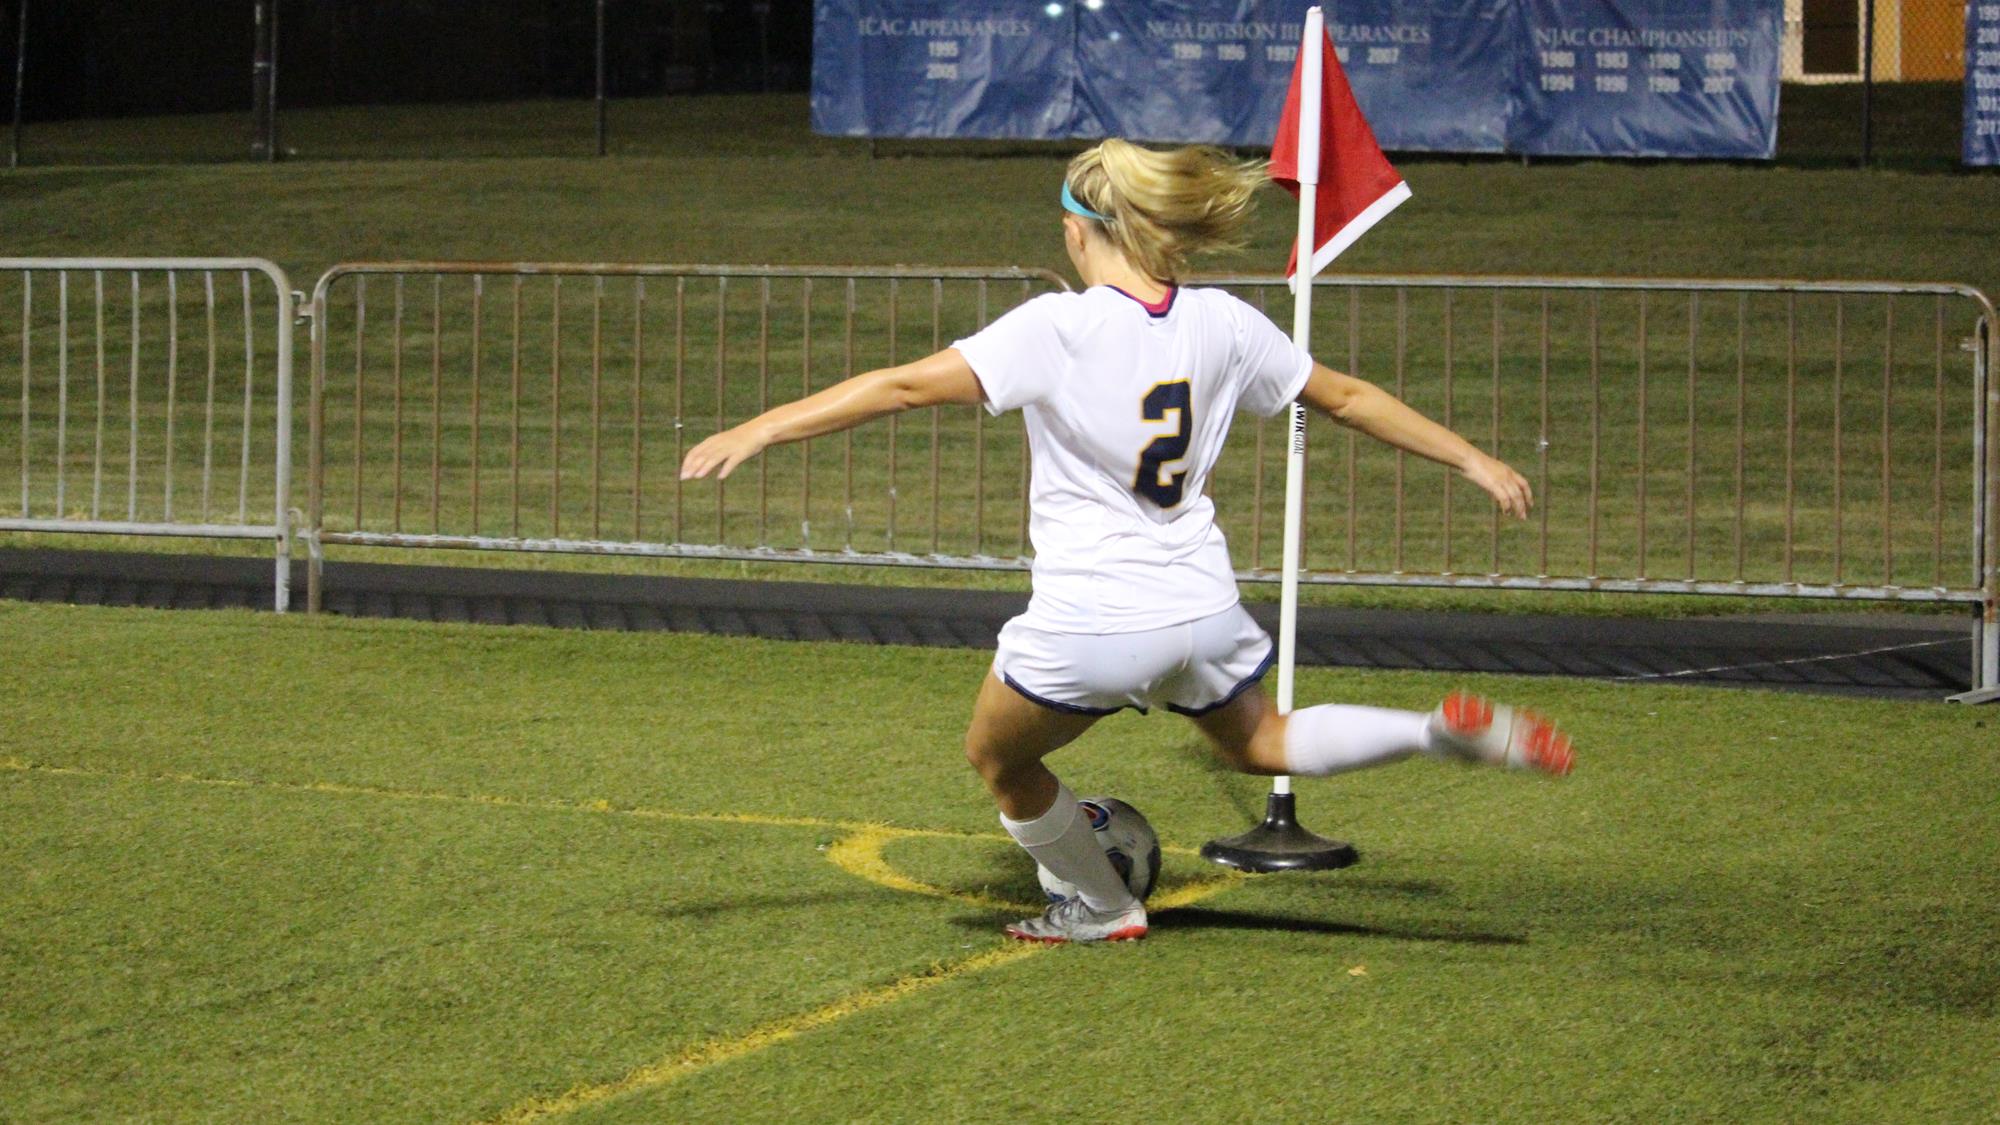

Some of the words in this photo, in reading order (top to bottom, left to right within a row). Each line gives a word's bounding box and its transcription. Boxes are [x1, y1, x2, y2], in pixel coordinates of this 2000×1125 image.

[1978, 5, 2000, 20] 199
[907, 20, 1030, 36] APPEARANCES
[1197, 22, 1277, 40] DIVISION
[1281, 23, 1300, 41] III
[1326, 24, 1432, 44] PEARANCES
[1977, 27, 2000, 44] 200
[1535, 28, 1586, 47] NJAC
[1588, 28, 1748, 48] CHAMPIONSHIPS
[1132, 377, 1192, 509] 2
